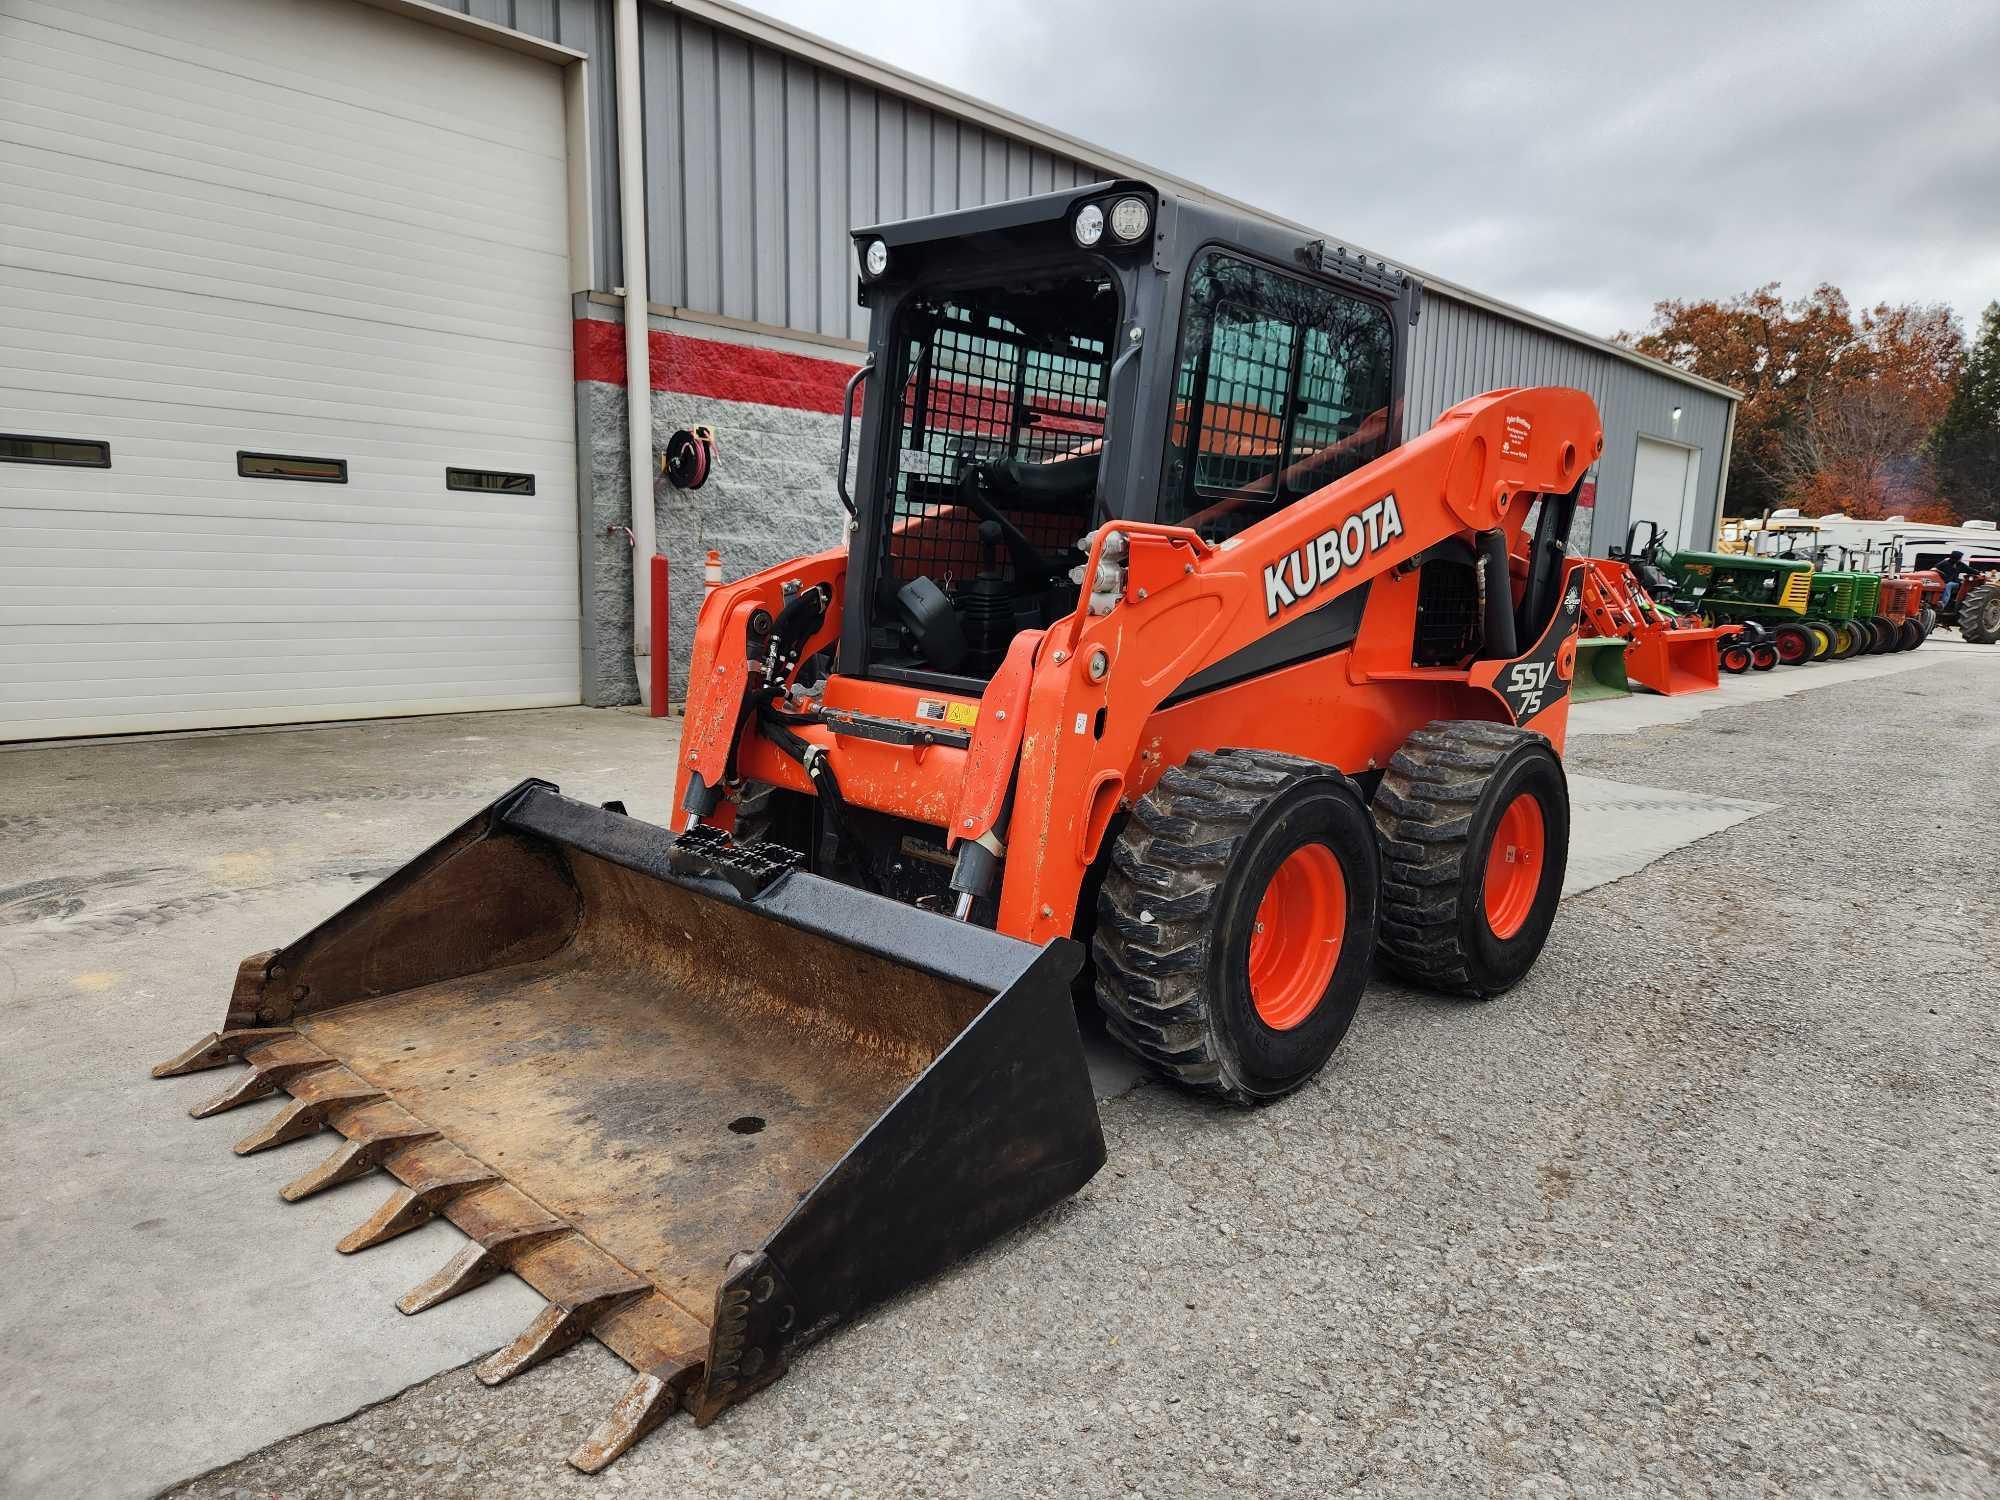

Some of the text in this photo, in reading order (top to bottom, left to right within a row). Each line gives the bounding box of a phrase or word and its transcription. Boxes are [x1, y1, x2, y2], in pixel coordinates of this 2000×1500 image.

[1263, 494, 1403, 618] KUBOTA
[1507, 661, 1555, 692] SSV
[1519, 691, 1543, 715] 75
